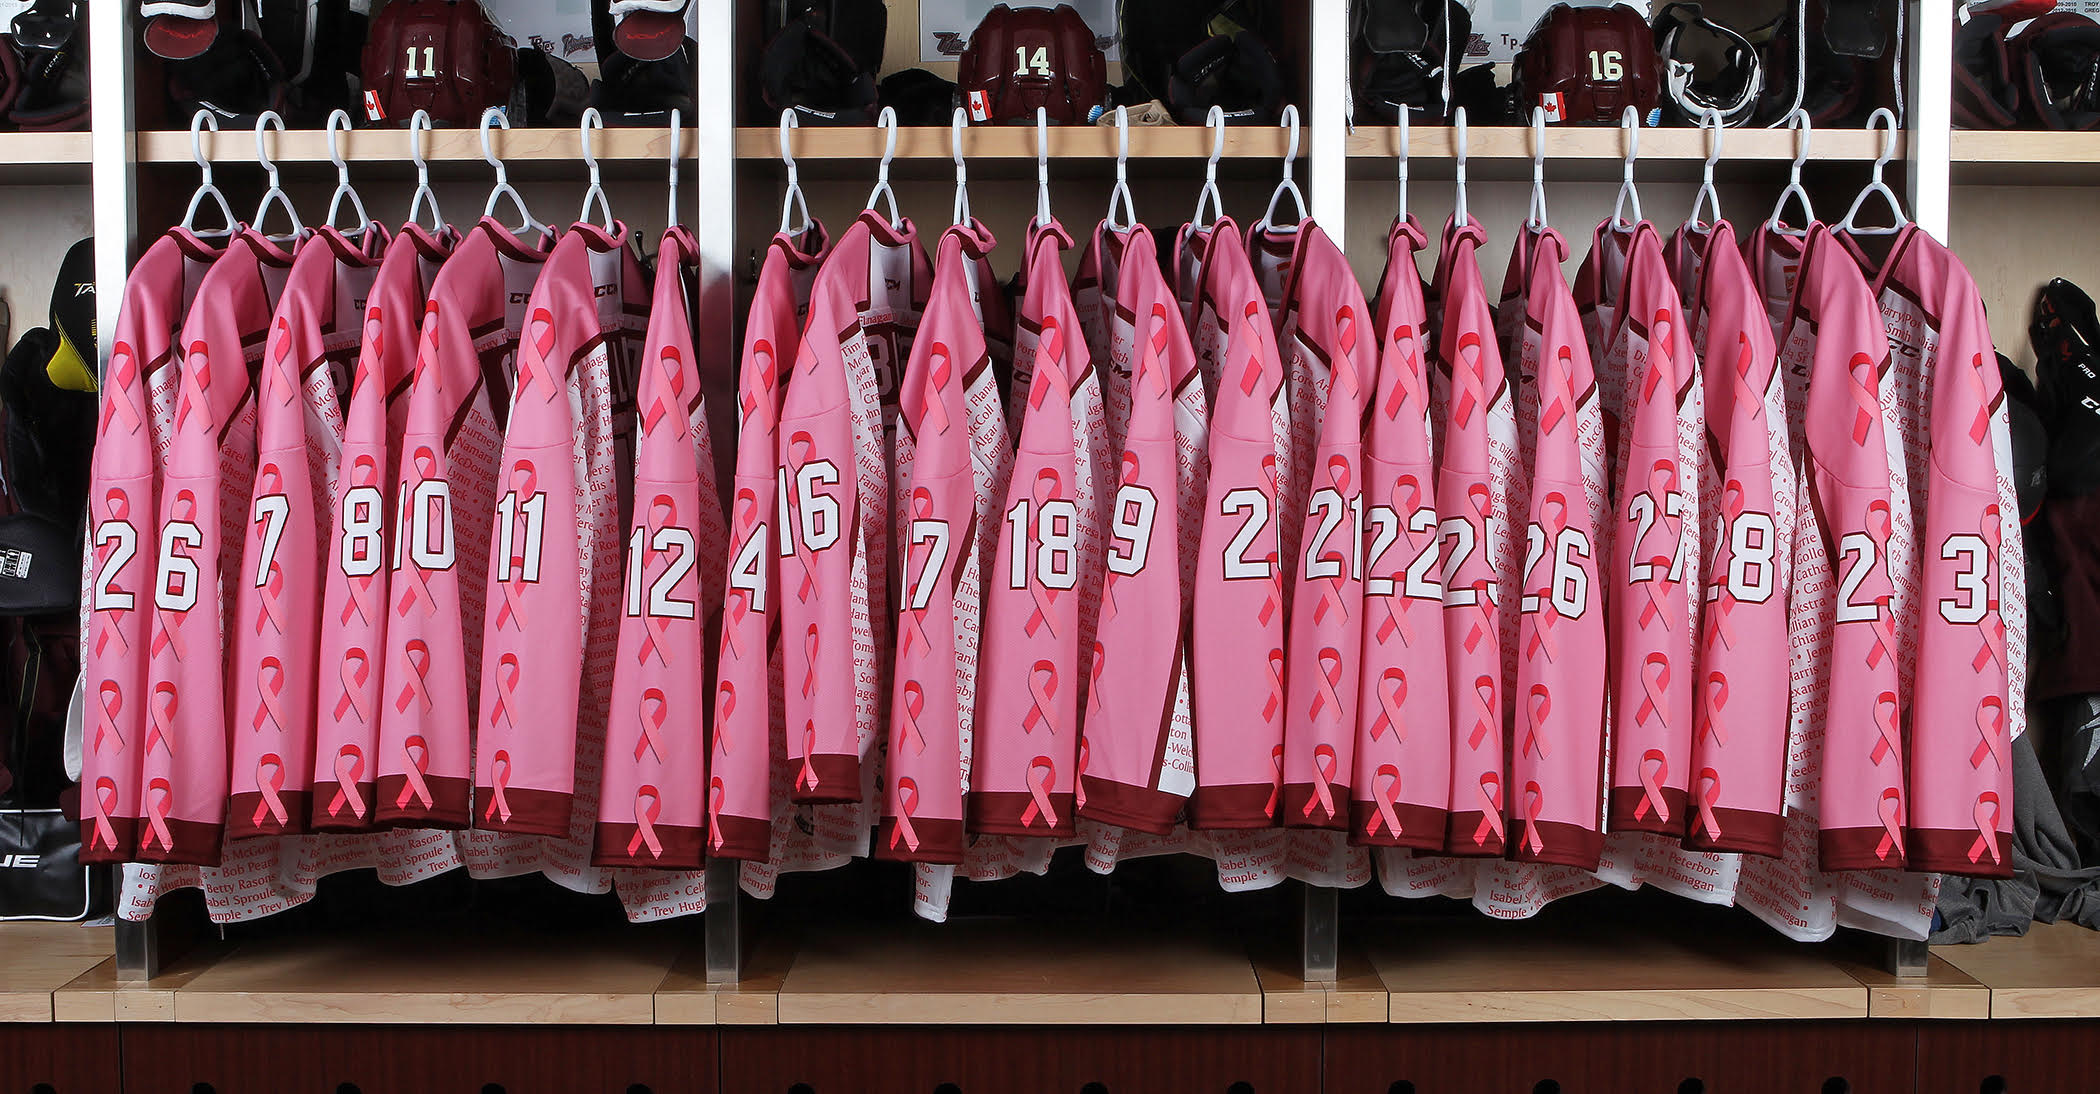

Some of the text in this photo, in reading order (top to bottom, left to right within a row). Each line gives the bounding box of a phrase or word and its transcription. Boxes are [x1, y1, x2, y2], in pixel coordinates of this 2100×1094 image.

[405, 47, 436, 78] 11
[1015, 46, 1050, 76] 14
[1589, 50, 1624, 81] 16
[841, 341, 861, 358] Tim
[2078, 363, 2096, 379] PRO
[305, 379, 325, 397] Tim
[975, 424, 998, 451] Algar
[447, 465, 471, 486] Lynn
[778, 458, 840, 557] 16
[254, 494, 289, 588] 7
[340, 486, 382, 576] 8
[496, 493, 547, 583] 11
[1221, 487, 1282, 580] 2
[1007, 500, 1077, 590] 18
[1362, 504, 1443, 601] 22
[94, 520, 137, 611] 2
[153, 519, 203, 611] 6
[626, 526, 696, 620] 12
[407, 832, 443, 850] Rasons
[404, 846, 443, 866] Sproule
[427, 860, 449, 873] Trev
[1669, 852, 1719, 876] Peterbor-
[206, 872, 277, 895] Betty Rasons
[222, 864, 245, 878] Bob
[1666, 867, 1715, 891] Flanagan
[233, 888, 276, 906] Sproule
[1490, 890, 1522, 904] Isabel
[1845, 873, 1895, 901] Flanagan
[258, 902, 282, 915] Trev
[652, 906, 675, 917] Trev
[1487, 904, 1527, 919] Semple
[1745, 884, 1770, 907] Peggy
[1770, 901, 1808, 928] Flanagan
